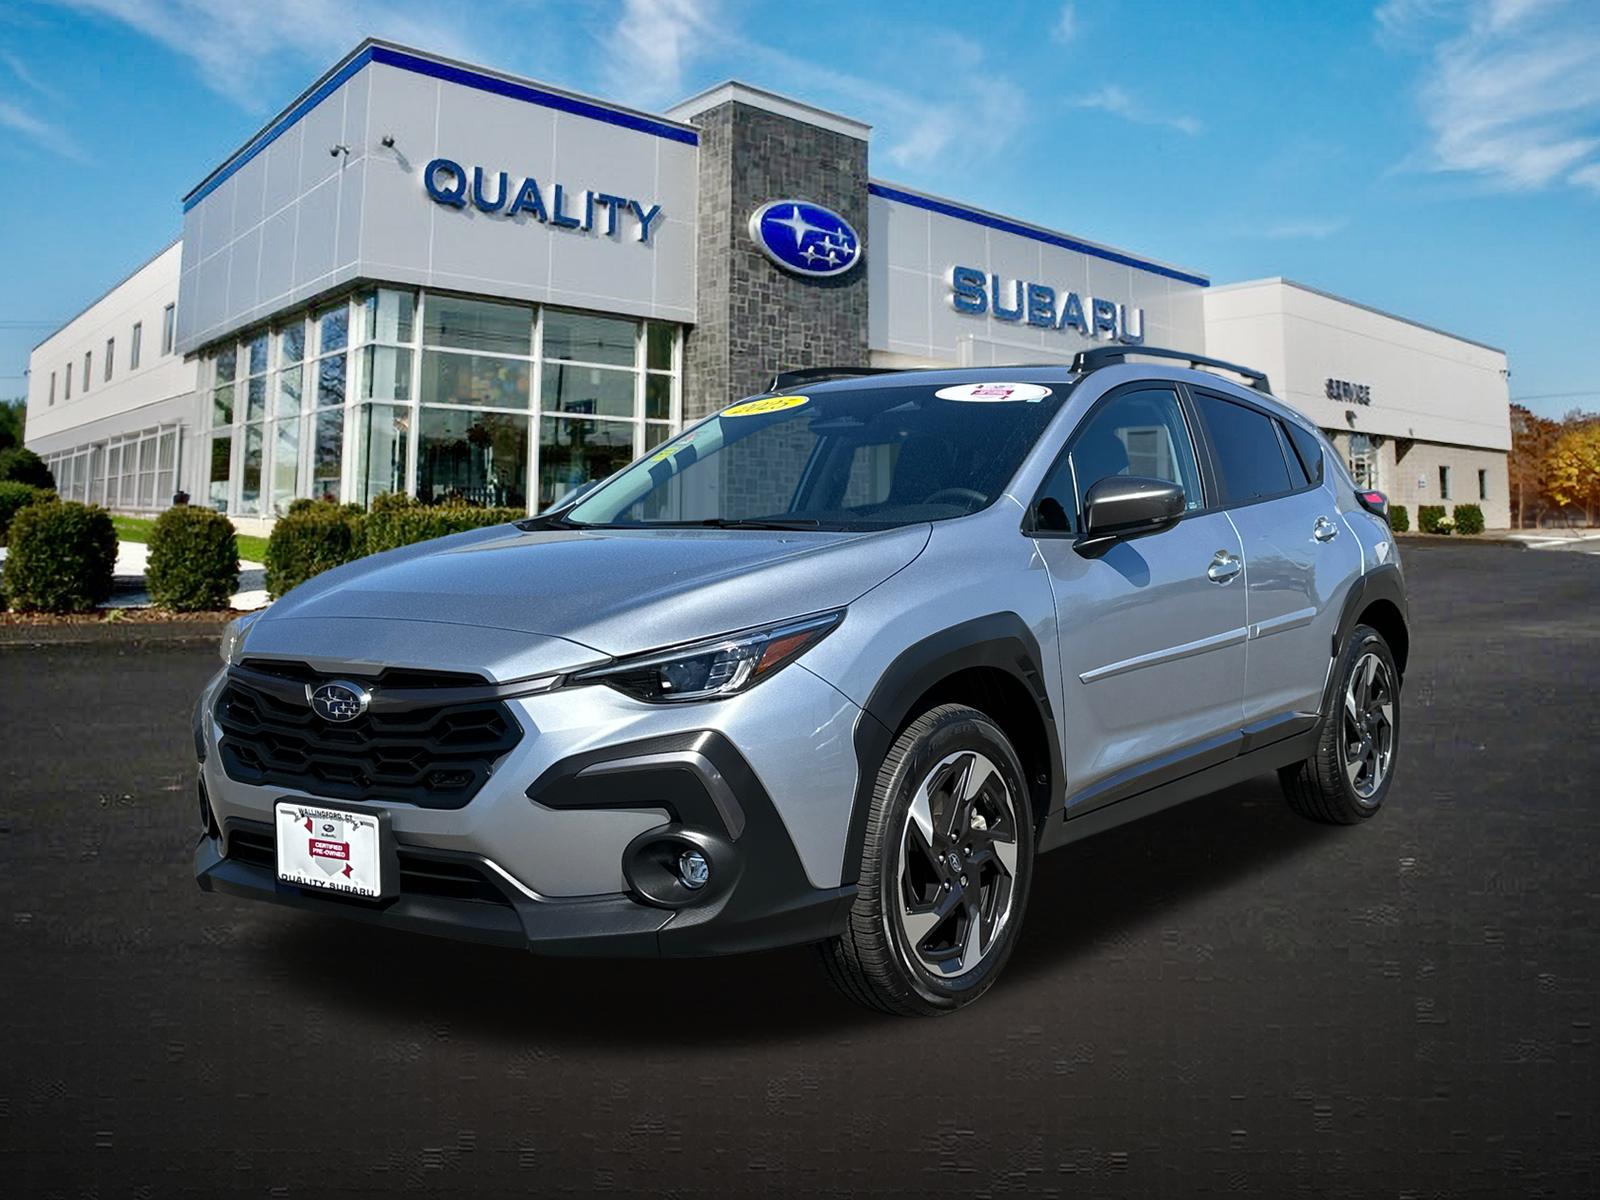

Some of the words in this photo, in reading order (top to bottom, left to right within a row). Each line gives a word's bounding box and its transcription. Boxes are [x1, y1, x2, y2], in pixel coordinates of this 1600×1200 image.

[423, 158, 662, 243] QUALITY
[947, 265, 1145, 345] SUBARU
[1324, 378, 1371, 406] SERVICE
[312, 848, 346, 858] PRE-OWNED
[314, 842, 343, 851] CERTIFIED
[281, 873, 326, 889] QUALITY
[329, 882, 374, 897] SUBARU
